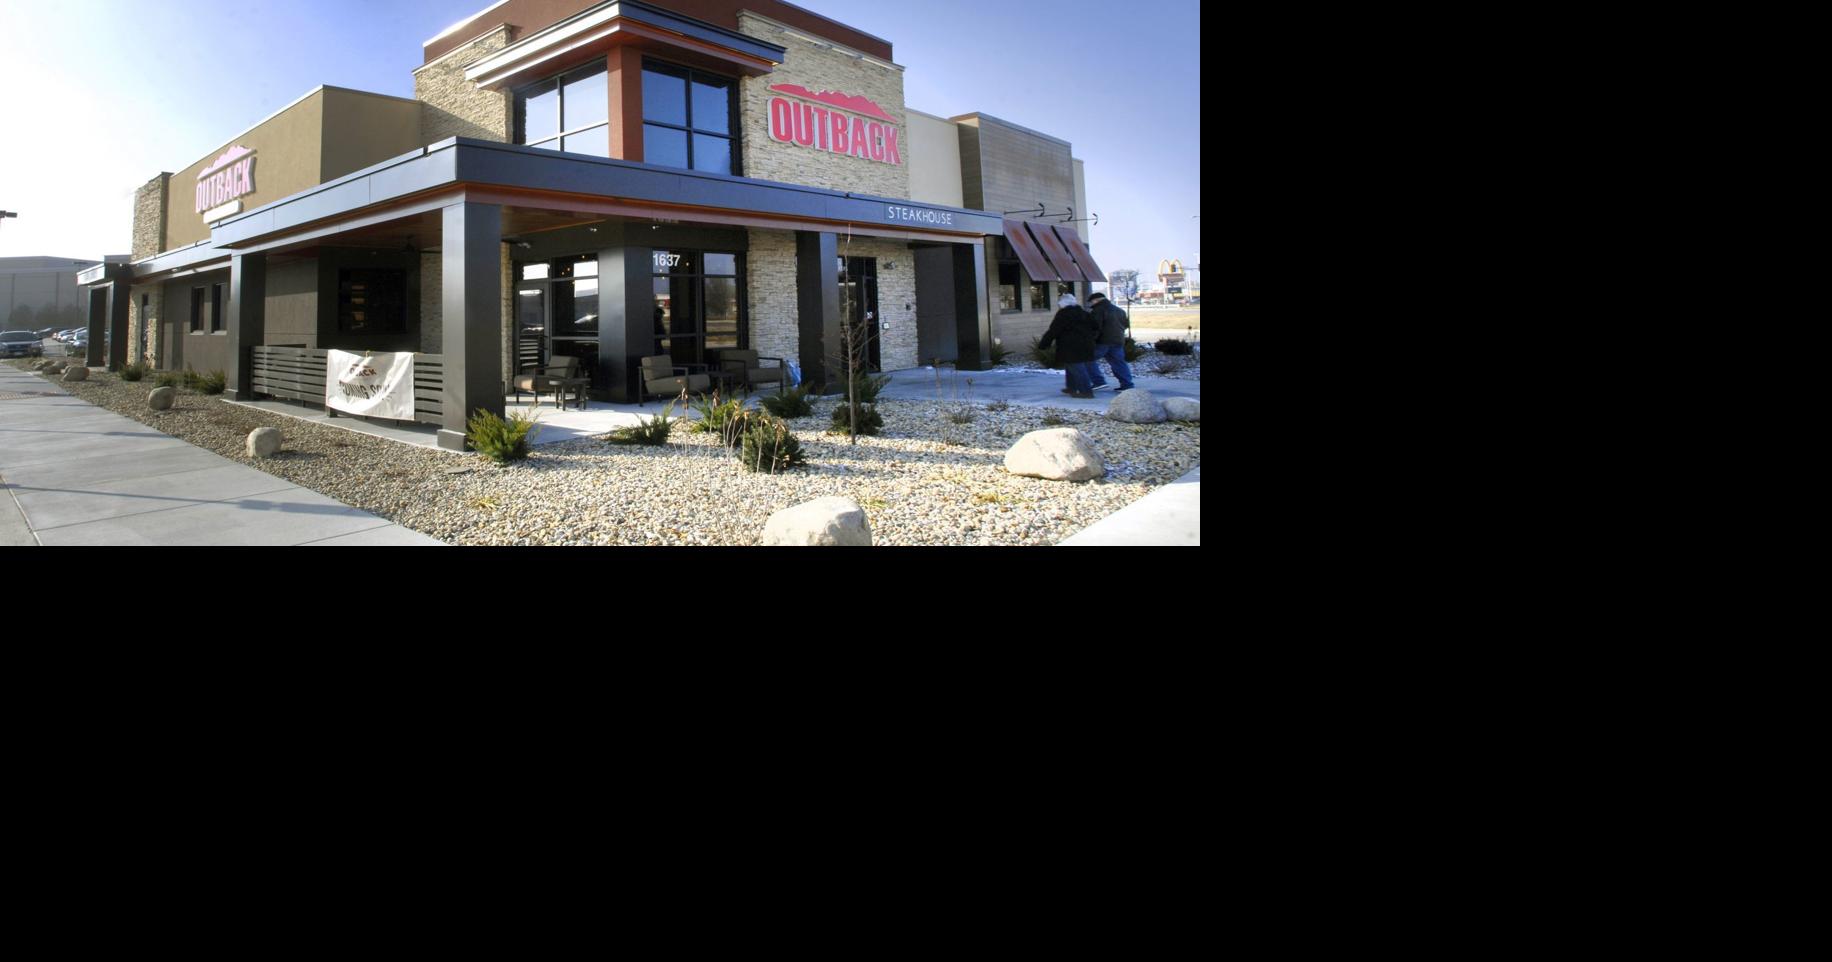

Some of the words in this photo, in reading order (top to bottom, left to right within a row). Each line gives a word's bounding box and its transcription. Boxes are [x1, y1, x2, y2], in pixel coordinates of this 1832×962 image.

[768, 97, 901, 165] OUTBACK
[195, 156, 254, 214] OUTBACK
[888, 206, 952, 225] STEAKHOUSE
[653, 254, 680, 267] 1637
